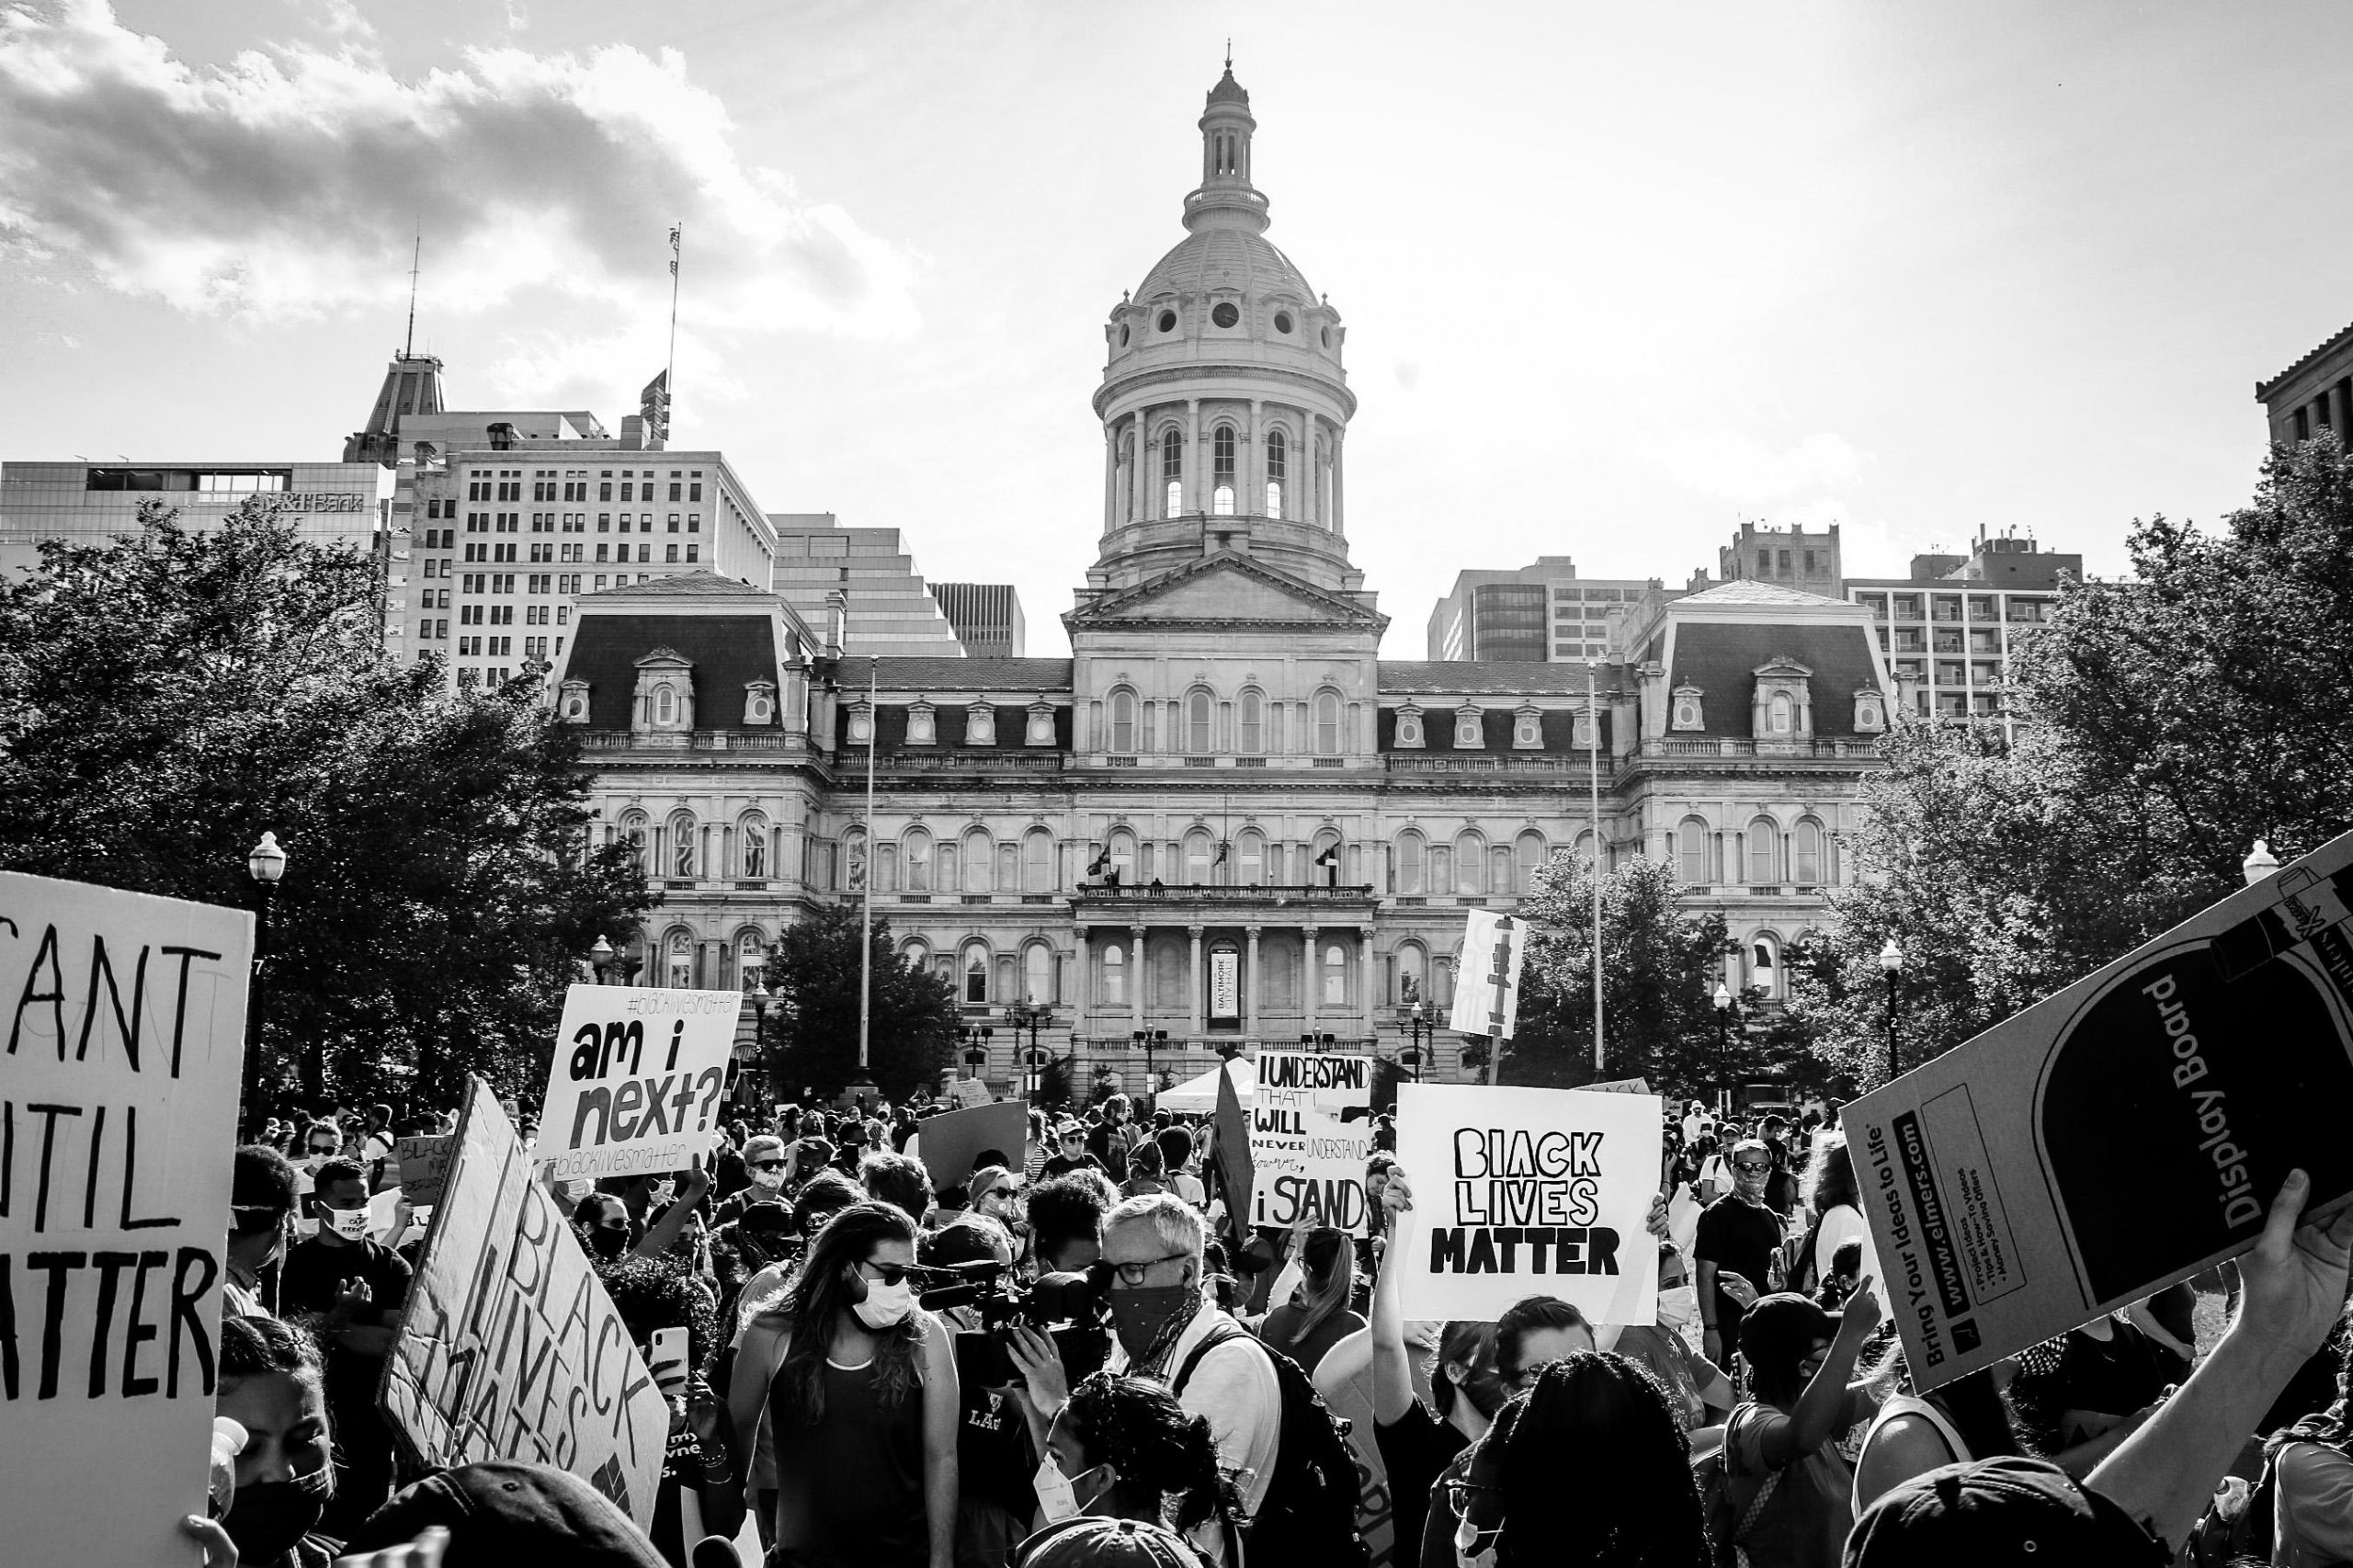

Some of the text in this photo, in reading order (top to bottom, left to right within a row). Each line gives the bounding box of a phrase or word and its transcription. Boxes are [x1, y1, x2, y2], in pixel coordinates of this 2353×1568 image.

[314, 493, 364, 513] Bank
[254, 959, 265, 975] 7
[0, 915, 222, 1079] ANT
[1890, 1017, 1898, 1028] 2
[570, 1018, 685, 1082] am i
[756, 1044, 762, 1053] 5
[1258, 1055, 1372, 1090] I UNDERSTAND
[568, 1066, 723, 1150] next?
[1254, 1108, 1307, 1136] WILL
[1256, 1088, 1317, 1108] THAT I
[2142, 972, 2263, 1231] Display Board
[0, 1100, 182, 1233] TIL
[1252, 1138, 1369, 1162] NEVER UNDERSTAND
[1257, 1175, 1365, 1229] i STAND
[1455, 1178, 1598, 1226] LIVES
[1958, 1167, 1972, 1205] Videos
[1901, 1121, 1963, 1306] www.elmers.com
[1970, 1169, 2007, 1276] Money Saving Offers
[1429, 1227, 1621, 1276] MATTER
[1867, 1127, 1946, 1369] Bring Your Ideas to Life
[1960, 1217, 1985, 1285] Project Ideas
[1980, 1246, 1989, 1257] &
[1984, 1257, 1995, 1281] Tips
[506, 1178, 650, 1469] BLACK
